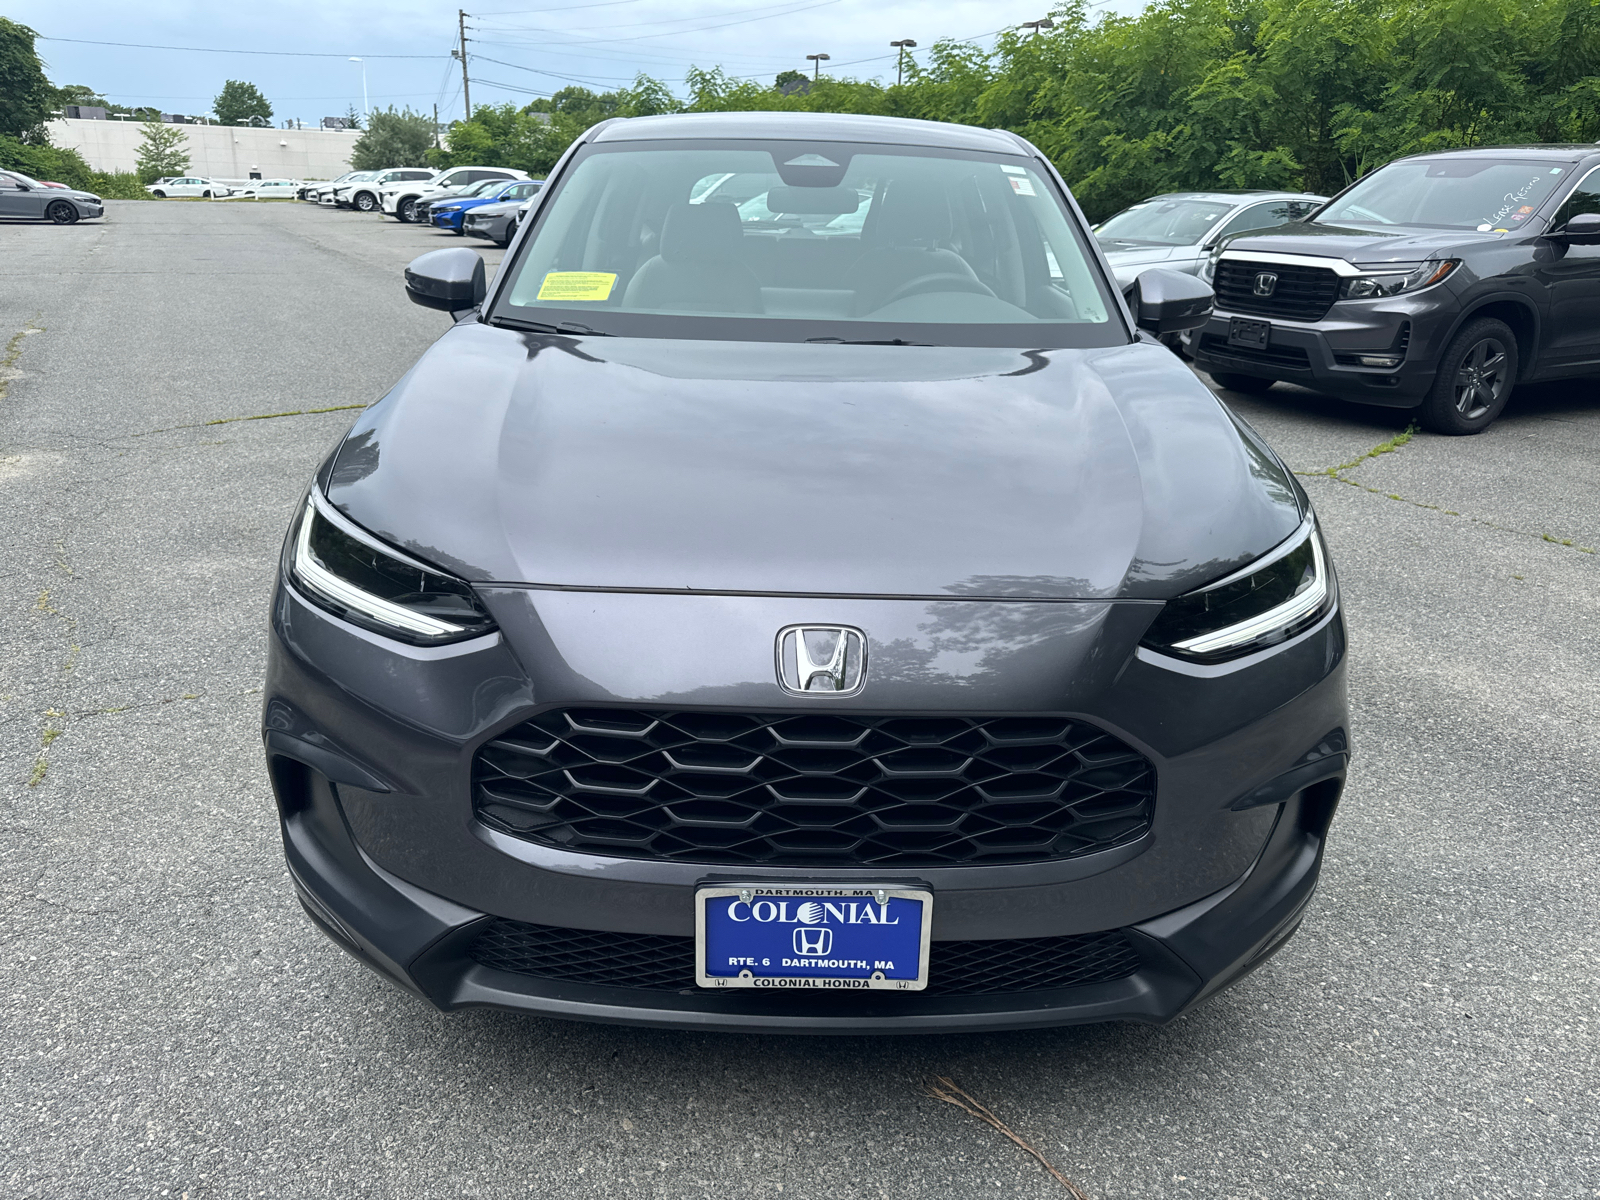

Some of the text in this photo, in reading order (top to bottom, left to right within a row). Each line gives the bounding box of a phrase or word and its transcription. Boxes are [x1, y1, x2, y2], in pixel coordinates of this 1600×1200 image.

[728, 900, 900, 925] COLONIAL
[728, 957, 895, 970] RTE. 6 DARTMOUTH, MA
[753, 978, 870, 989] COLONIAL HONDA
